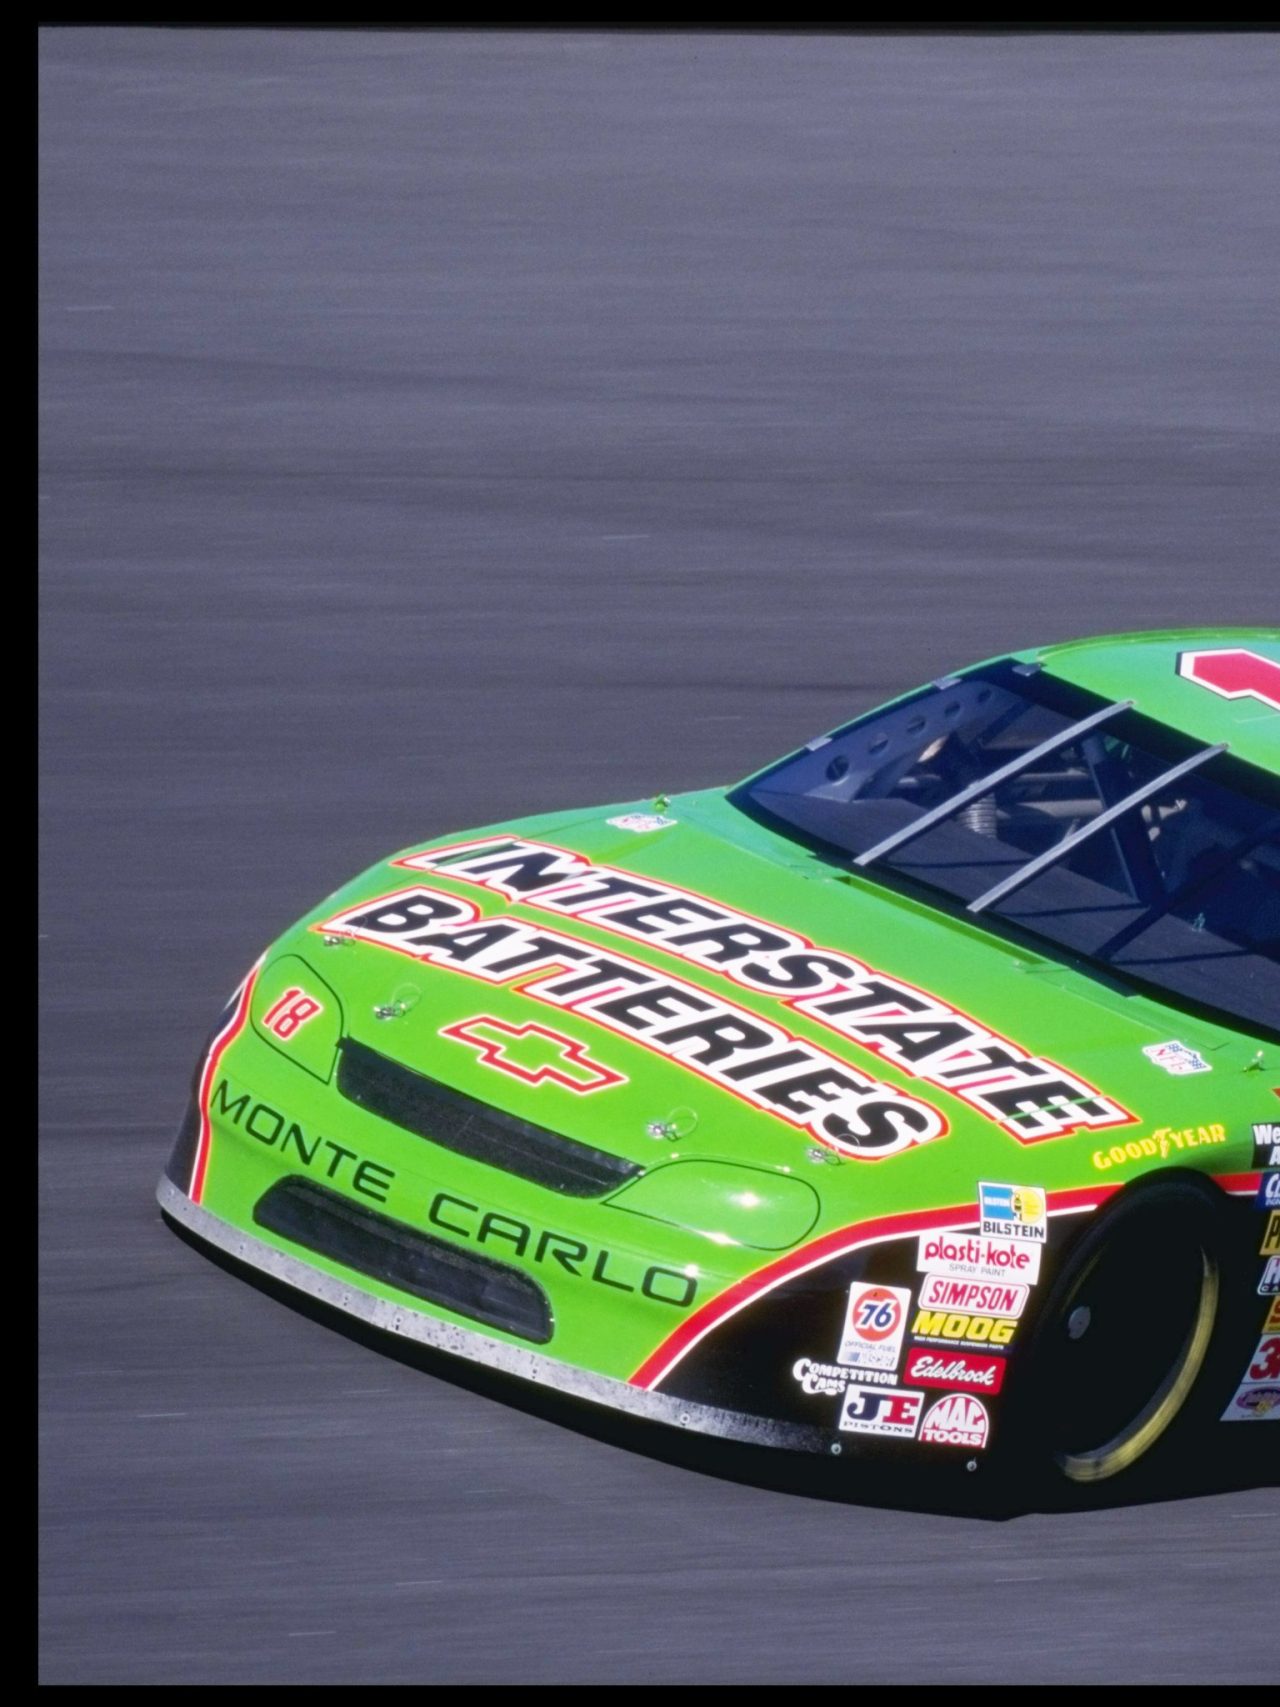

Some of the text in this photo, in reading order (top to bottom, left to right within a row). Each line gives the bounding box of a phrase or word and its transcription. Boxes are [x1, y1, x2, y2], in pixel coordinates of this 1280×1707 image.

[405, 838, 1130, 1140] INTERSTATE
[262, 988, 323, 1041] 18
[335, 889, 942, 1157] BATTERIES
[1092, 1123, 1226, 1169] GOODYEAR
[210, 1079, 699, 1307] MONTE CARLO
[983, 1220, 1045, 1238] BILSTEIN
[924, 1236, 1030, 1270] plasti-kote
[949, 1263, 1006, 1277] SPRAY PAINT
[929, 1280, 1019, 1311] SIMPSON
[859, 1302, 894, 1327] 76
[912, 1310, 1018, 1344] MOOG
[793, 1358, 898, 1386] COMPETITION
[802, 1374, 846, 1395] CAMS
[910, 1355, 997, 1386] Edelbrock
[847, 1391, 920, 1425] JE
[925, 1396, 987, 1431] MAC
[843, 1419, 914, 1434] PISTONS
[922, 1428, 983, 1445] TOOLS
